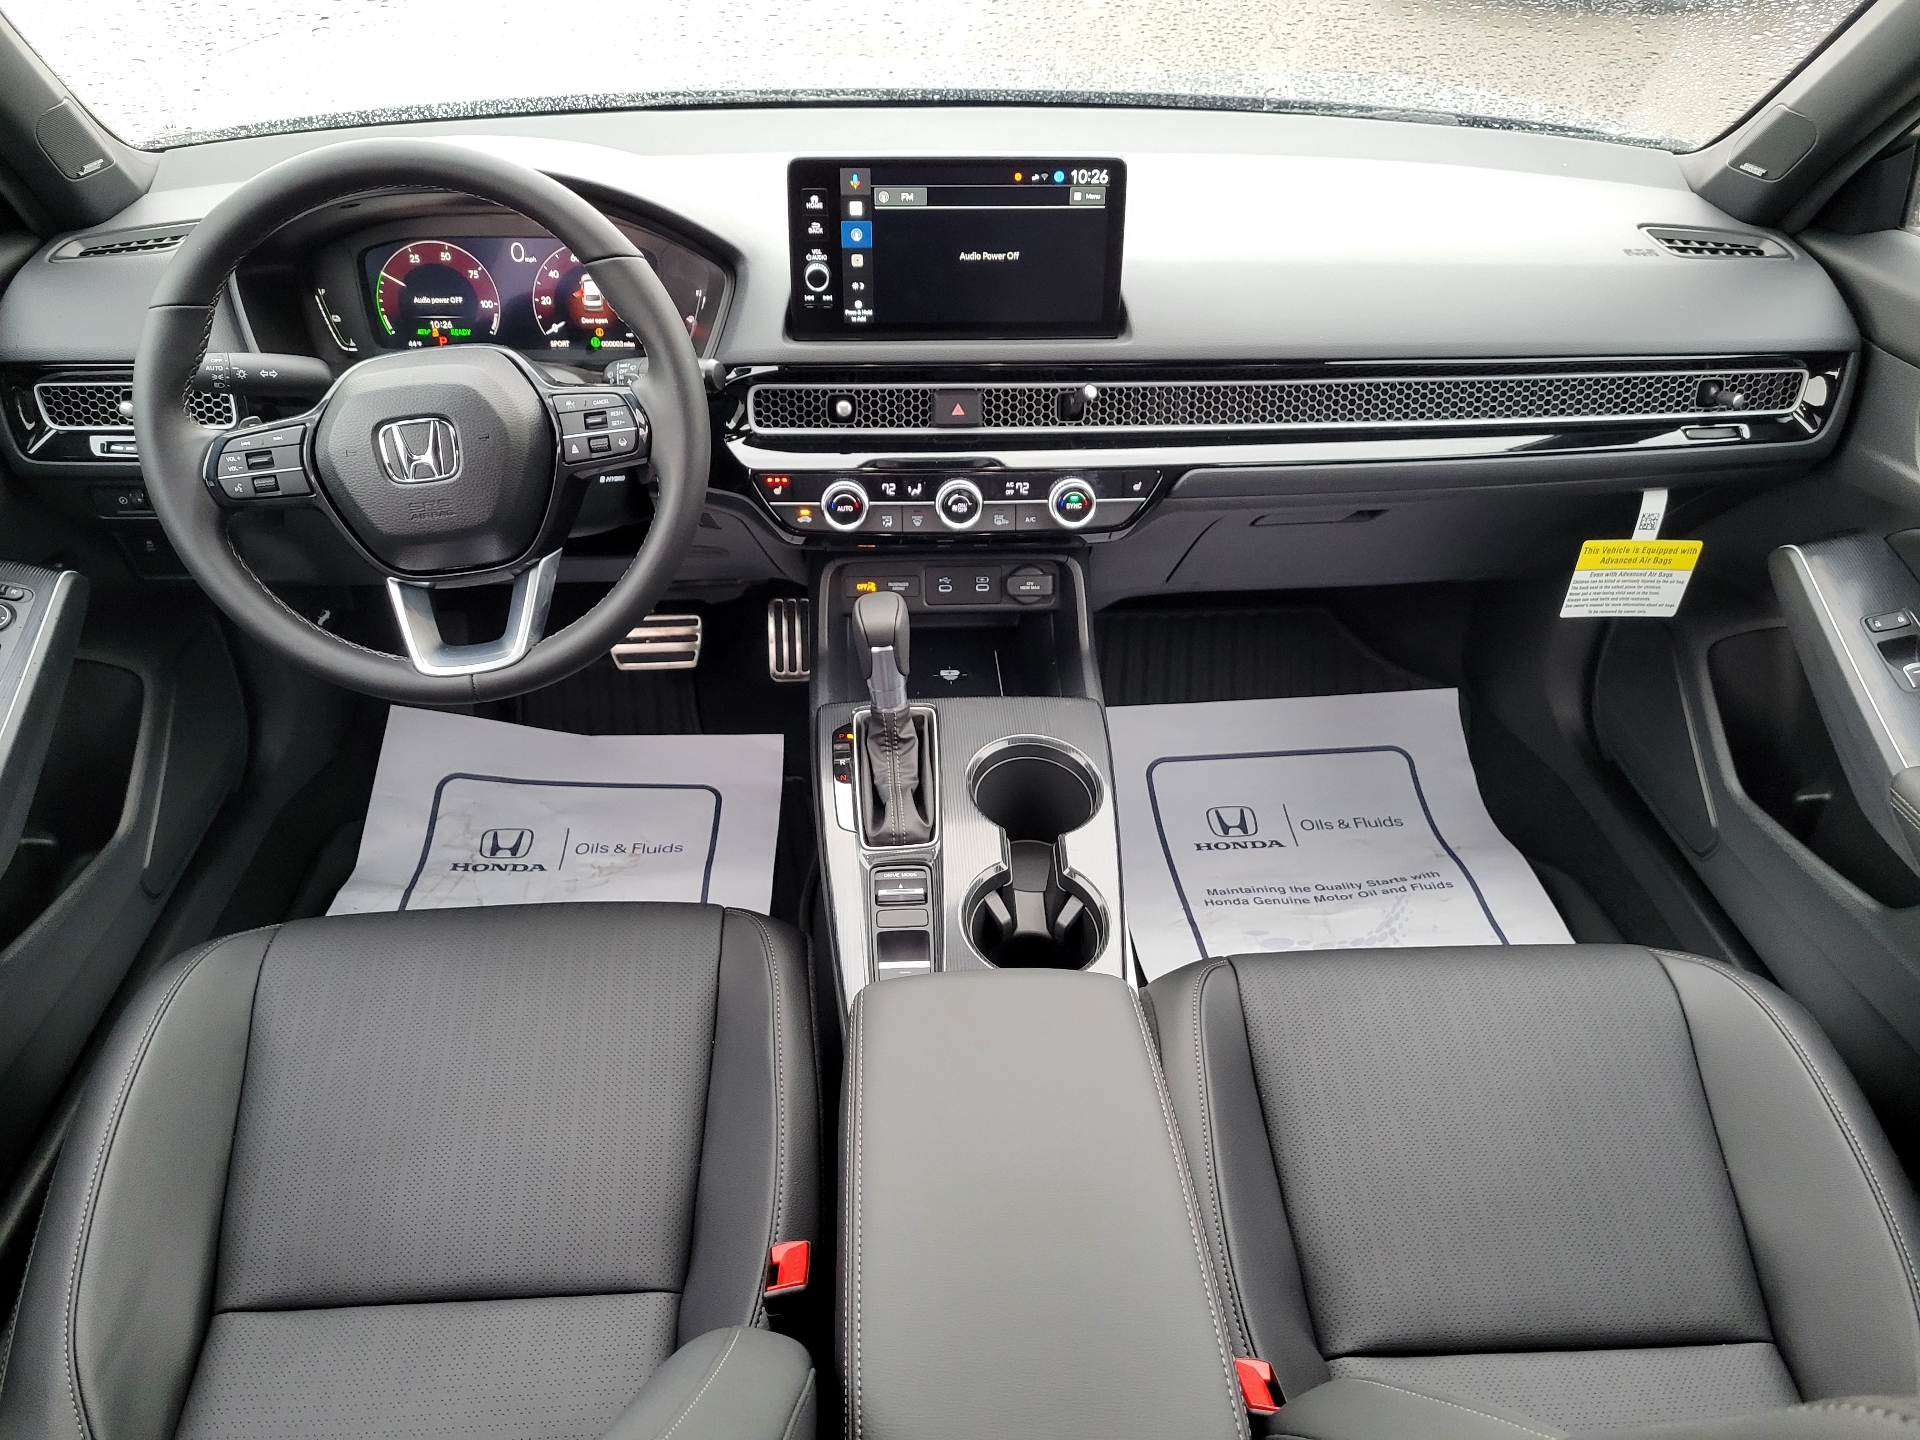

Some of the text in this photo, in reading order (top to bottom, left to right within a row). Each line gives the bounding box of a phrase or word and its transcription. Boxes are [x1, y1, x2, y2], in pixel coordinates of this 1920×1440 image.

[1070, 168, 1109, 184] 10:26
[900, 192, 914, 202] FM
[1085, 192, 1101, 200] Menu
[805, 202, 823, 210] HOME
[807, 227, 823, 235] BACK
[440, 252, 451, 261] 50
[510, 242, 524, 263] 0
[959, 251, 1020, 261] Audio Power Off
[409, 254, 420, 263] 25
[468, 270, 479, 279] 75
[548, 269, 559, 279] 40
[413, 296, 463, 305] Audio power OFF
[480, 300, 494, 309] 100
[541, 296, 552, 305] 20
[429, 320, 453, 330] 10:26
[439, 335, 448, 347] P
[550, 340, 570, 348] SPORT
[592, 398, 610, 406] CANCEL
[881, 483, 897, 496] 72
[1015, 482, 1030, 494] 72
[1065, 502, 1083, 510] SYNC
[1584, 547, 1600, 555] This
[1602, 546, 1630, 554] Vehicle
[1641, 546, 1679, 556] Equipped
[1680, 547, 1698, 555] with
[1599, 556, 1638, 565] Advanced
[1653, 557, 1673, 566] Bags
[1300, 815, 1404, 831] Oils & Fluids
[575, 842, 684, 855] Oils & Fluids
[1193, 839, 1287, 851] HONDA
[449, 862, 547, 872] HONDA
[1206, 871, 1441, 896] Maintaining the Quality Starts with
[1204, 881, 1454, 907] Honda Genuine Motor Oil and Fluids
